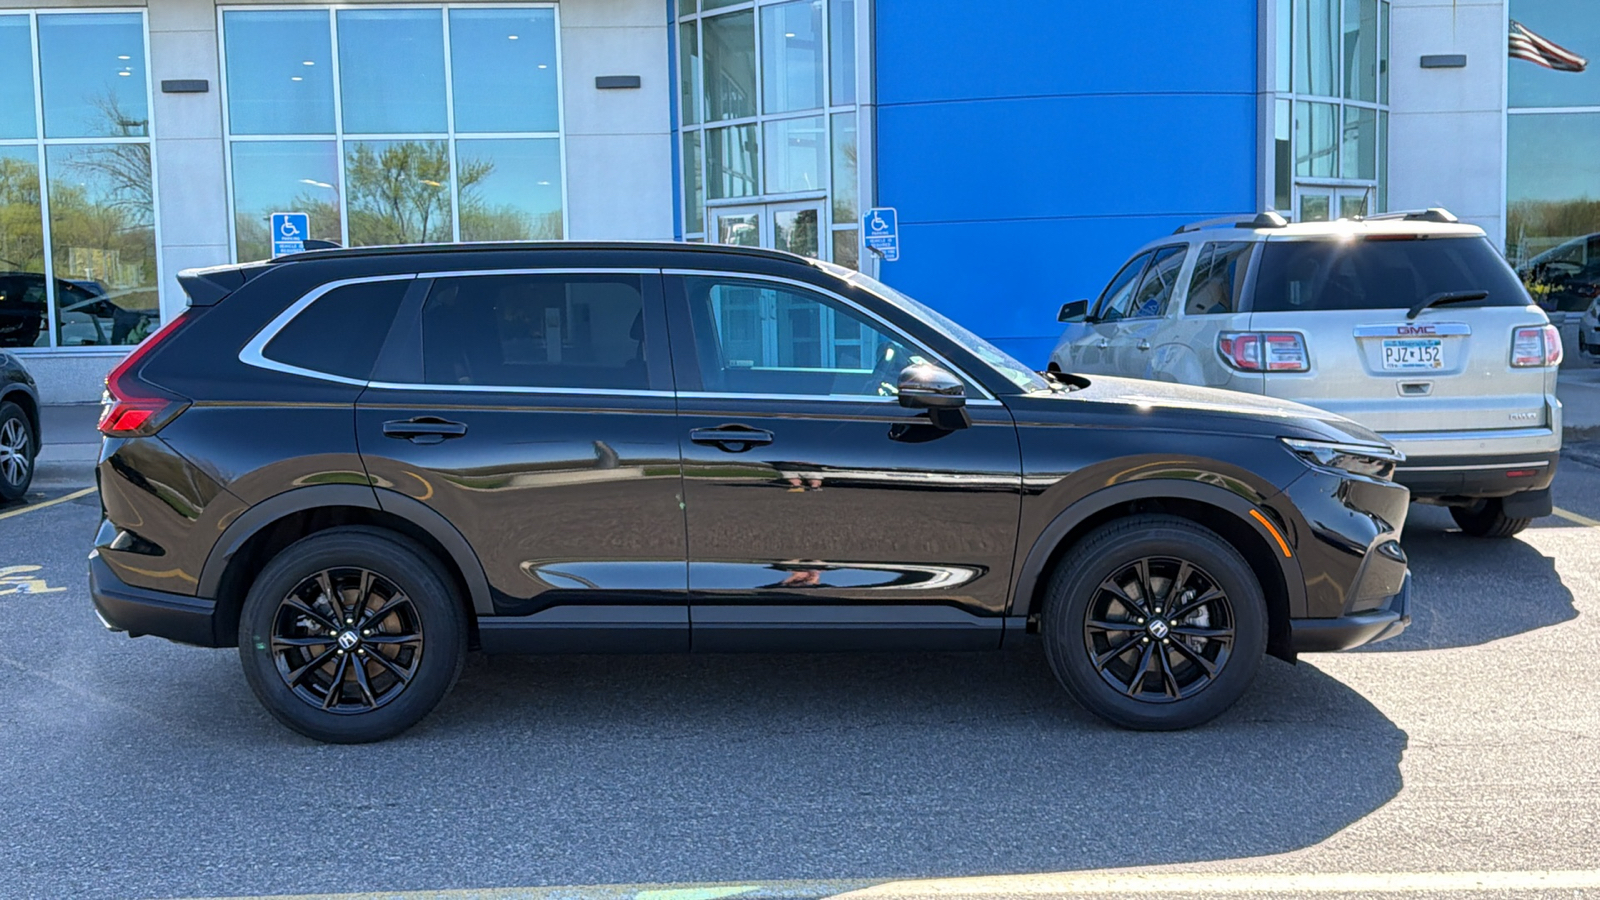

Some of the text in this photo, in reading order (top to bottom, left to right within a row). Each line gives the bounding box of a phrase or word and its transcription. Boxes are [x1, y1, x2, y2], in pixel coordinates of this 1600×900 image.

[1397, 326, 1436, 334] GMC
[1386, 346, 1440, 363] PJZ 152
